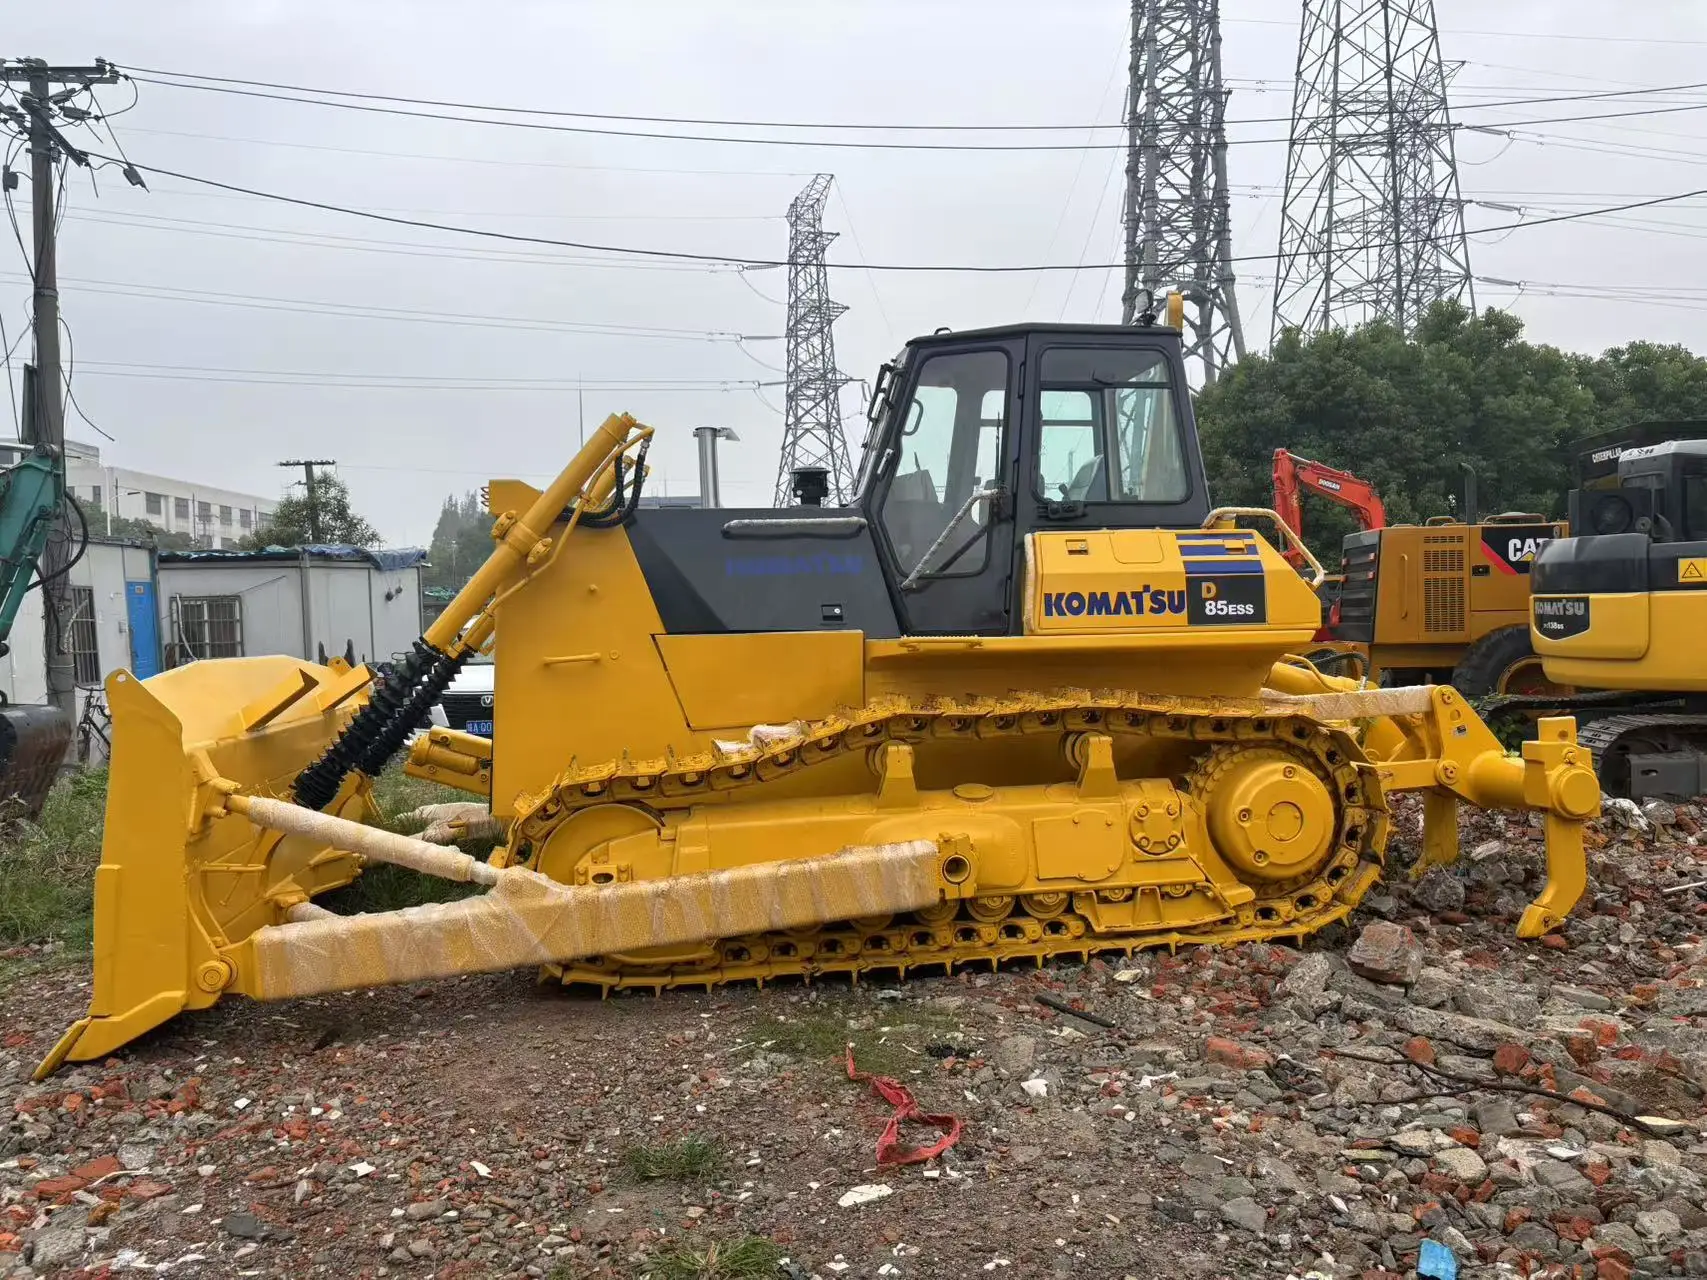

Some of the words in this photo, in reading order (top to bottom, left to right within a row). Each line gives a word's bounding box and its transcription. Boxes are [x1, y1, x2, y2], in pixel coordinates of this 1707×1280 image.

[1202, 582, 1216, 599] D
[1044, 584, 1186, 616] KOMATSU
[1205, 600, 1254, 616] 85ESS
